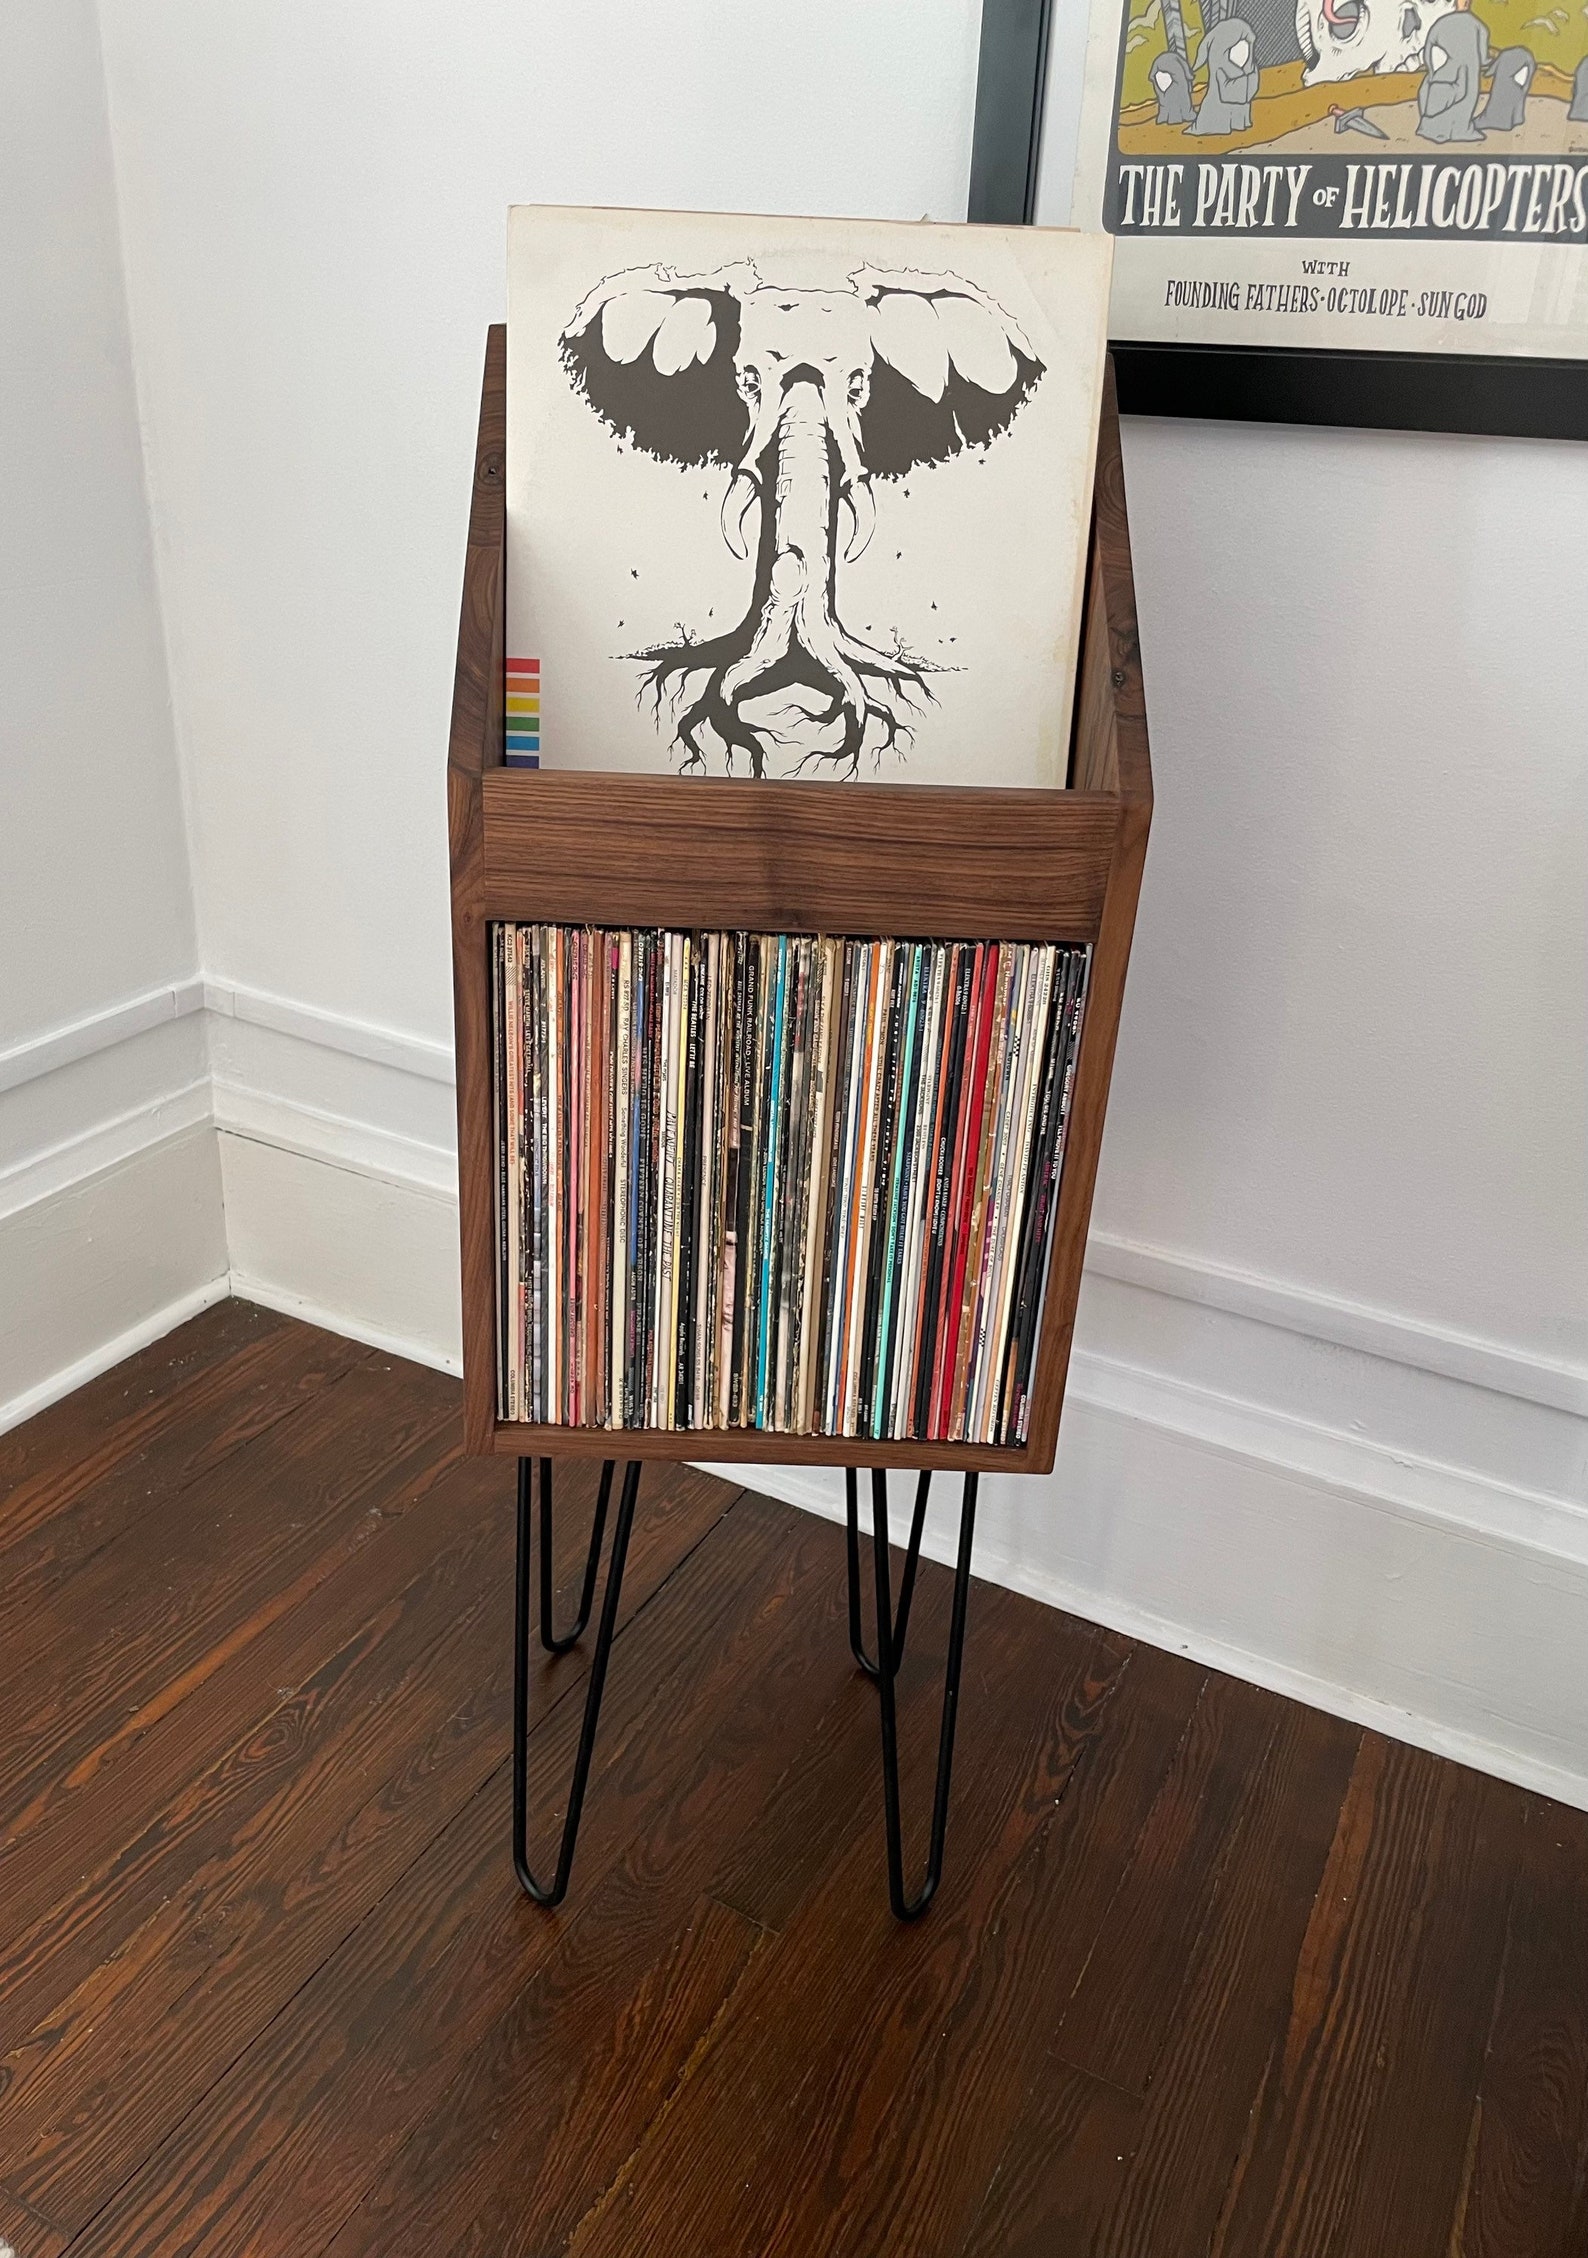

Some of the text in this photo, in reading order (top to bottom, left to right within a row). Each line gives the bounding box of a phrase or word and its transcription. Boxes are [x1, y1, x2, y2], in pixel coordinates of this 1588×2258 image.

[1118, 163, 1588, 234] THE PARTY OF HELICOPTERS
[1302, 259, 1350, 277] WITH
[1164, 280, 1240, 311] FOUNDING
[744, 1017, 752, 1055] RAILROAD
[619, 1107, 627, 1137] Something
[637, 1237, 643, 1249] OF
[663, 1240, 672, 1255] THE
[662, 1260, 672, 1281] PAST
